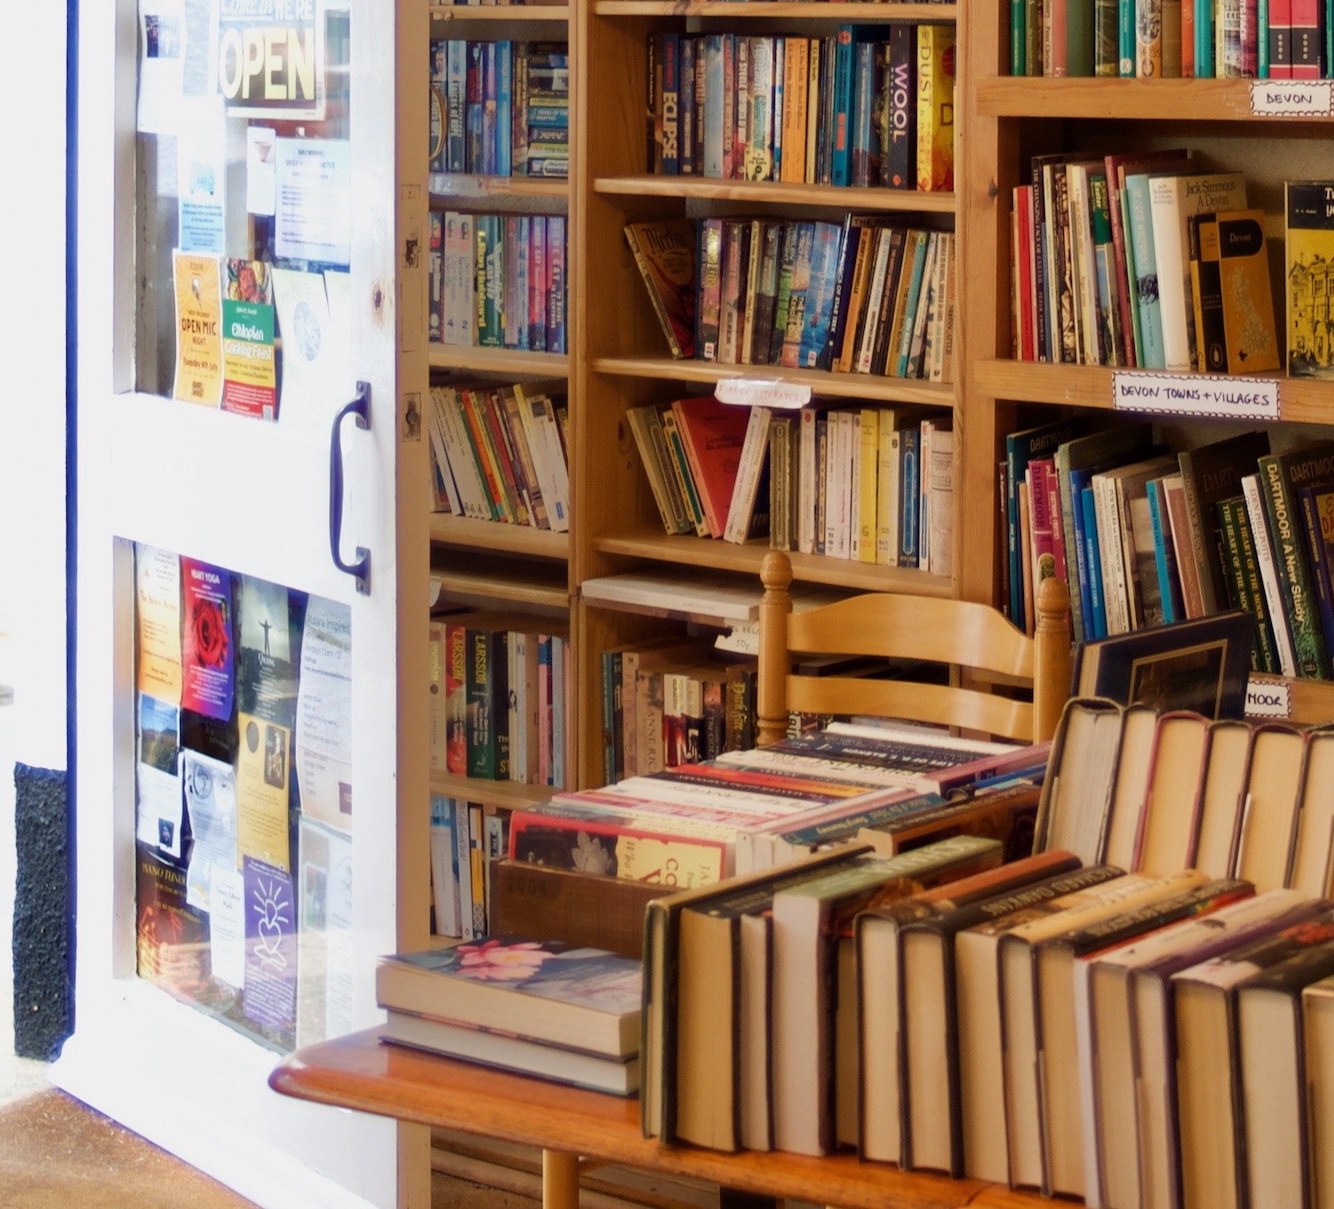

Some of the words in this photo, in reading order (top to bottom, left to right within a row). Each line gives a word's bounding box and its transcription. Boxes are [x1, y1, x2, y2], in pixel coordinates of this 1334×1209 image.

[219, 27, 314, 101] OPEN
[920, 46, 931, 104] DUST
[893, 63, 908, 142] WOOL
[1267, 93, 1312, 104] DEVON
[181, 318, 201, 335] OPEN
[203, 320, 217, 335] MIC
[231, 322, 264, 341] Ethiopian
[225, 340, 252, 359] Cooking
[252, 344, 272, 360] Feast
[1121, 385, 1160, 398] DEVON
[1163, 387, 1201, 401] TOWNS
[1213, 391, 1270, 406] VILLAGES
[204, 570, 220, 585] YOGA
